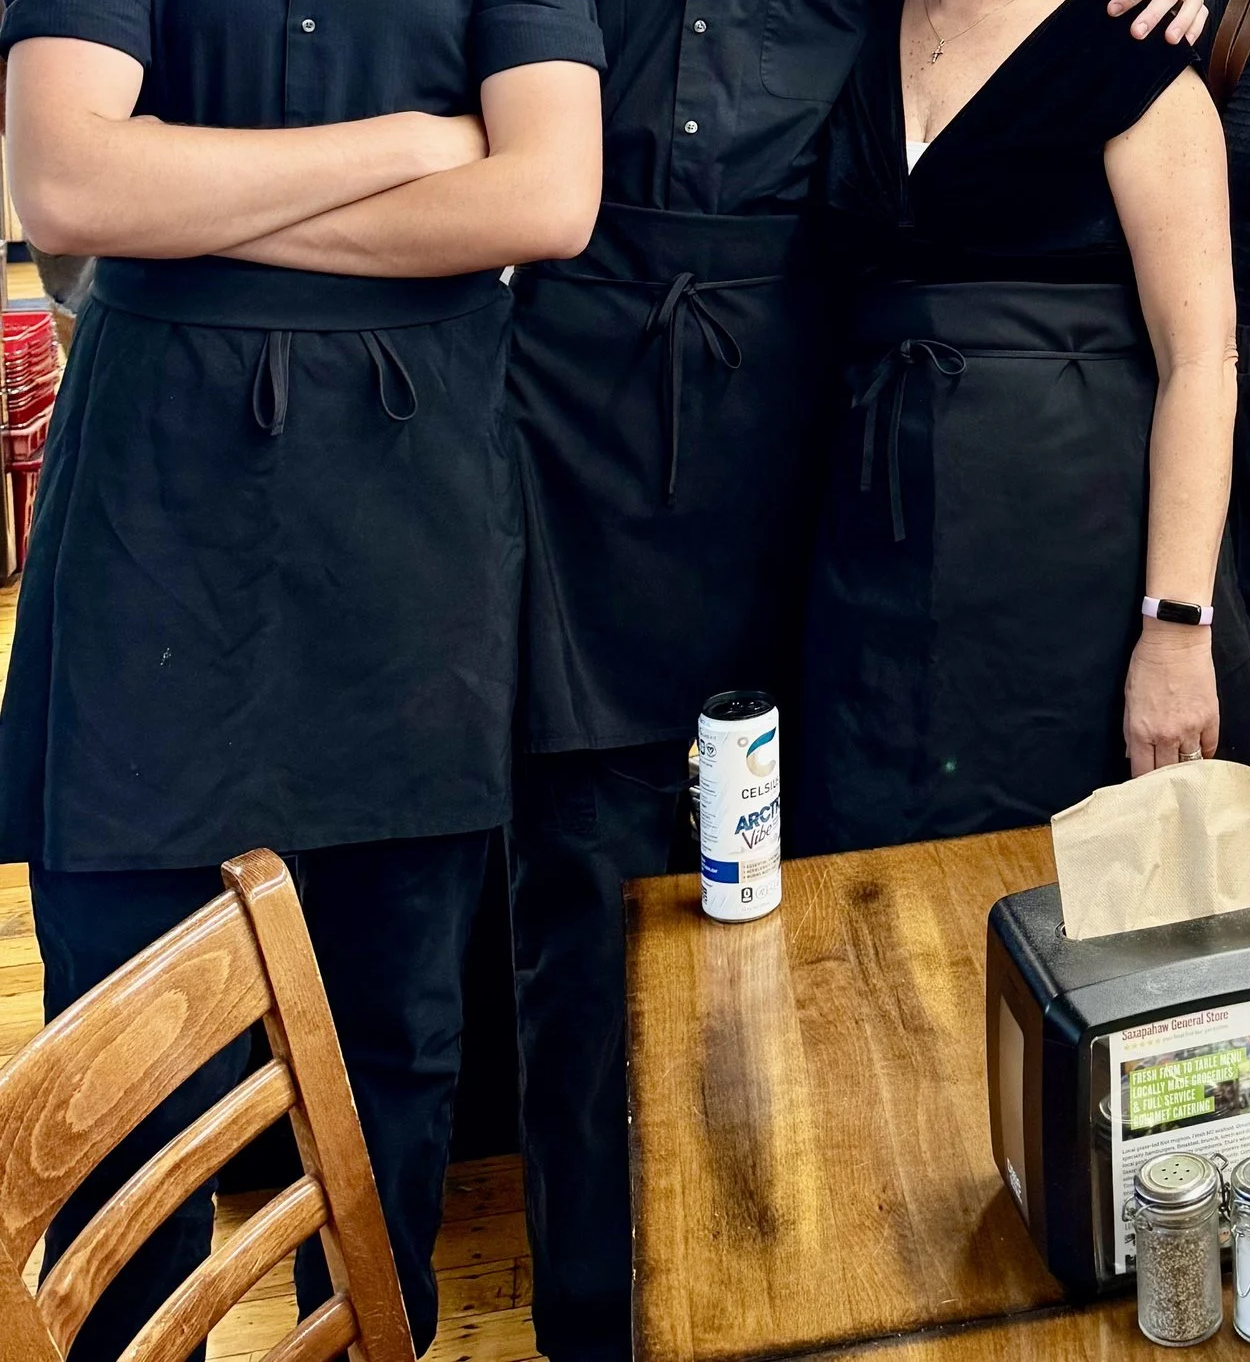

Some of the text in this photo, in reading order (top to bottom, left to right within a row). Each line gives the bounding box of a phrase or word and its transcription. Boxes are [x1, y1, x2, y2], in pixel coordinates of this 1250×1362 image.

[741, 822, 773, 849] Vibe
[1122, 1022, 1169, 1042] Saxapahaw
[1171, 1016, 1205, 1033] General
[1205, 1010, 1229, 1024] Store
[1132, 1051, 1242, 1086] FRESH FARM TO TABLE MENU
[1132, 1066, 1234, 1099] LOCALLY MADE GROCERIES
[1132, 1089, 1196, 1113] & FULL SERVICE
[1173, 1101, 1211, 1120] CATERING
